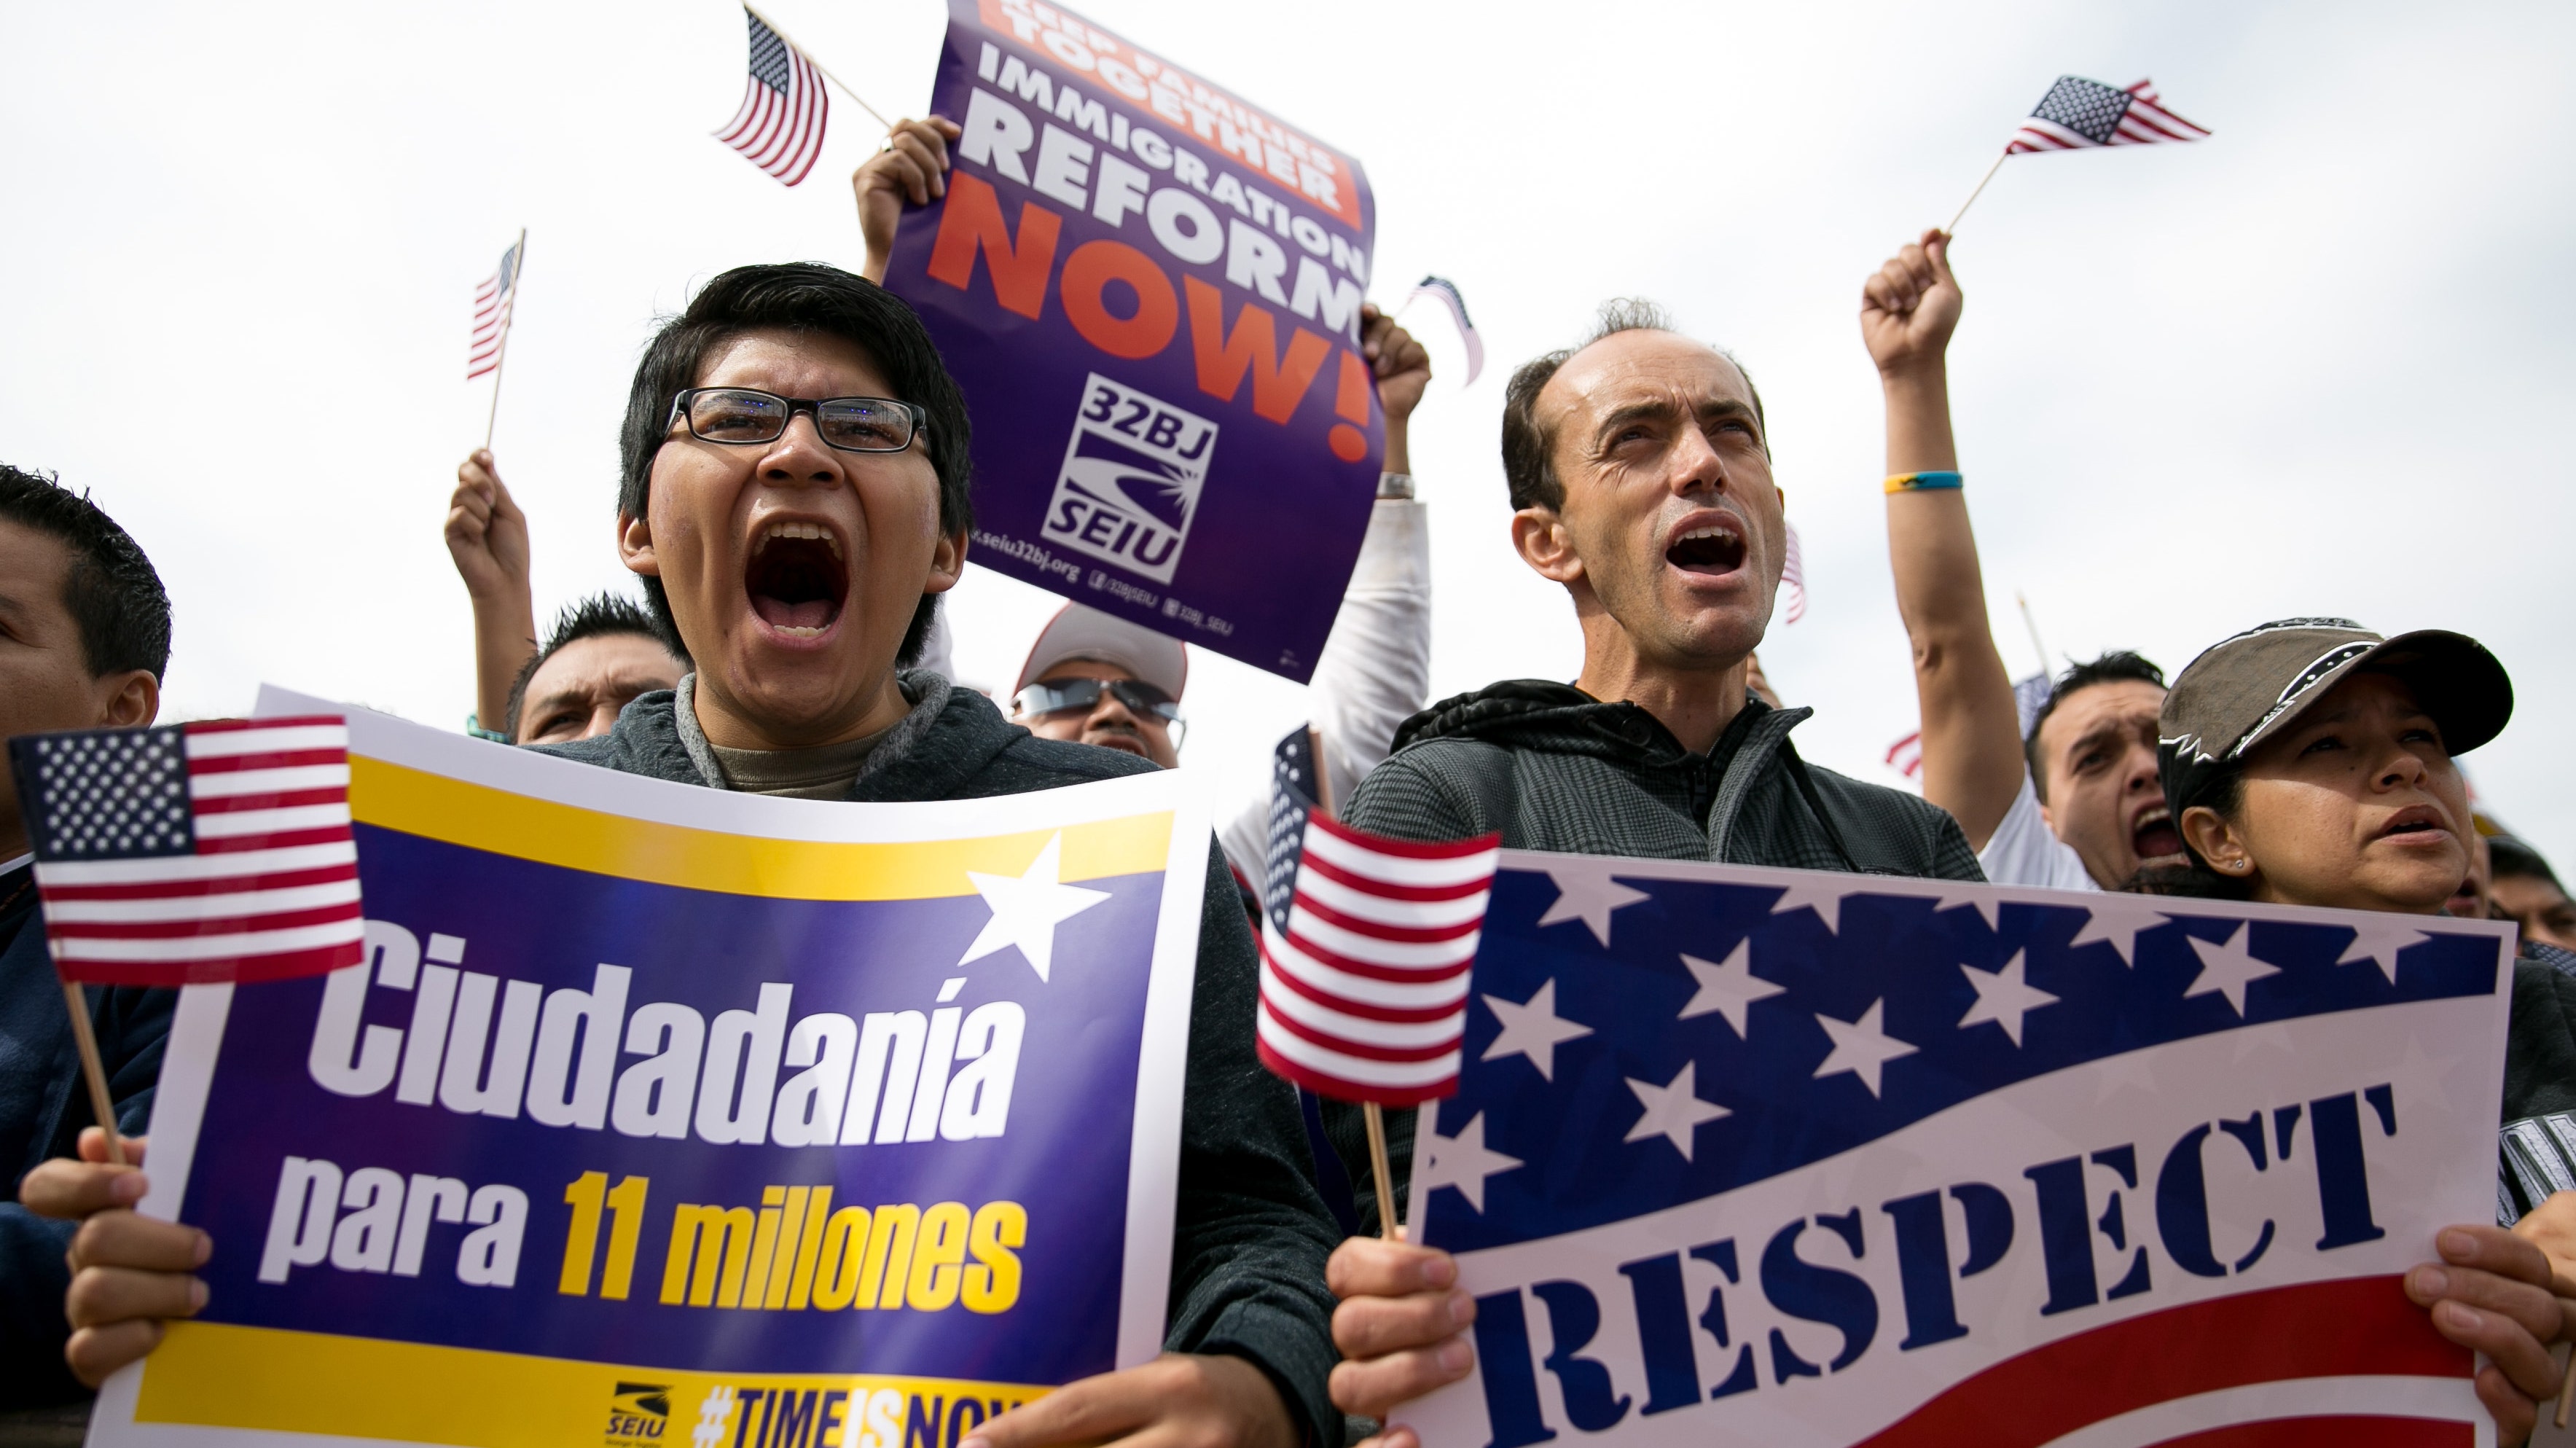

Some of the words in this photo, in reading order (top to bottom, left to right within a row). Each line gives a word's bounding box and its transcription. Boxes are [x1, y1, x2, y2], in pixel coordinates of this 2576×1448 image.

[977, 41, 1366, 286] IMMIGRATION
[1001, 5, 1342, 213] TOGETHER
[1133, 53, 1336, 176] FAMILIES
[958, 87, 1361, 347] REFORM
[927, 169, 1370, 463] NOW!
[1082, 385, 1213, 460] 32BJ
[1049, 498, 1180, 567] SEIU
[308, 919, 1027, 1148] Ciudadanía
[258, 1155, 529, 1288] para
[558, 1170, 650, 1300] 11
[659, 1185, 1028, 1314] millones
[1473, 1081, 2397, 1448] RESPECT
[605, 1416, 666, 1438] SEIU
[691, 1385, 1023, 1448] #TIMEISNO
